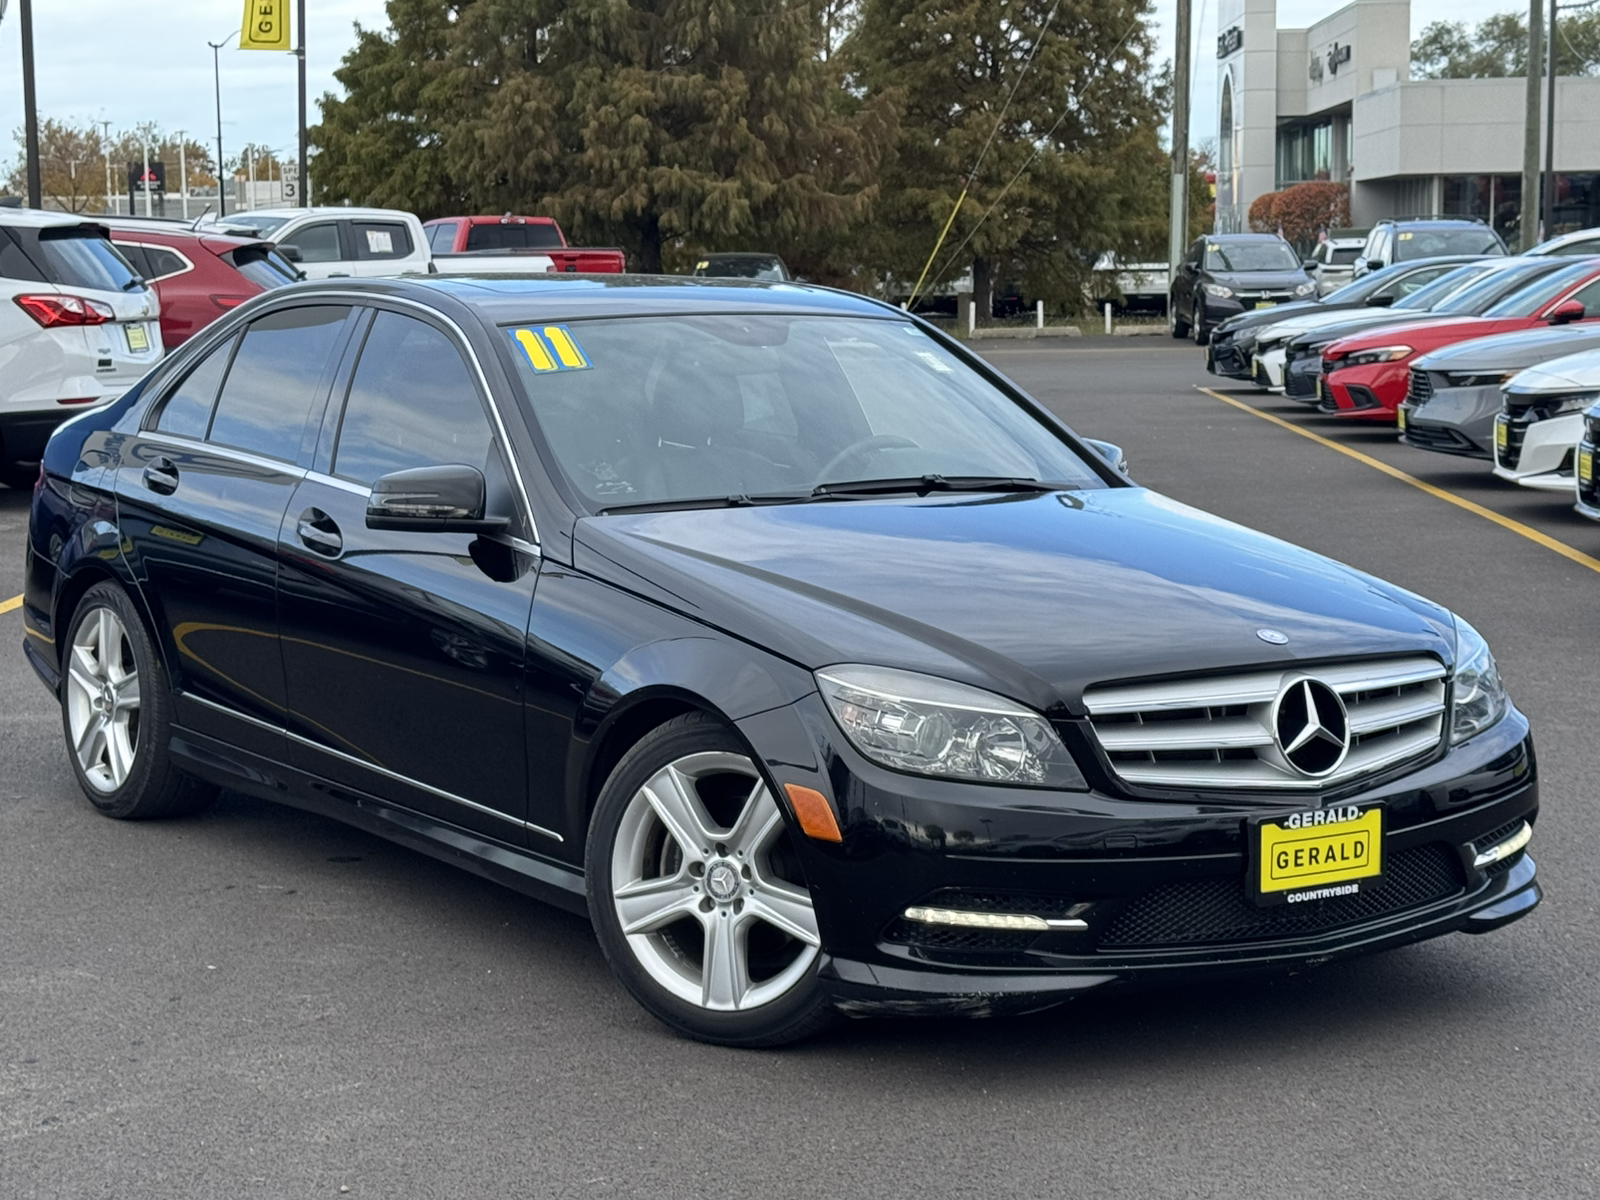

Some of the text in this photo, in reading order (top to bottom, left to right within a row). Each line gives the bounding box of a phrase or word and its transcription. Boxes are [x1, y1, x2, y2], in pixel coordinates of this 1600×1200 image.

[258, 0, 273, 33] GE
[285, 183, 296, 197] 3
[515, 326, 588, 370] 11
[1288, 805, 1359, 829] GERALD
[1276, 840, 1365, 869] GERALD
[1287, 883, 1359, 903] COUNTRYSIDE
